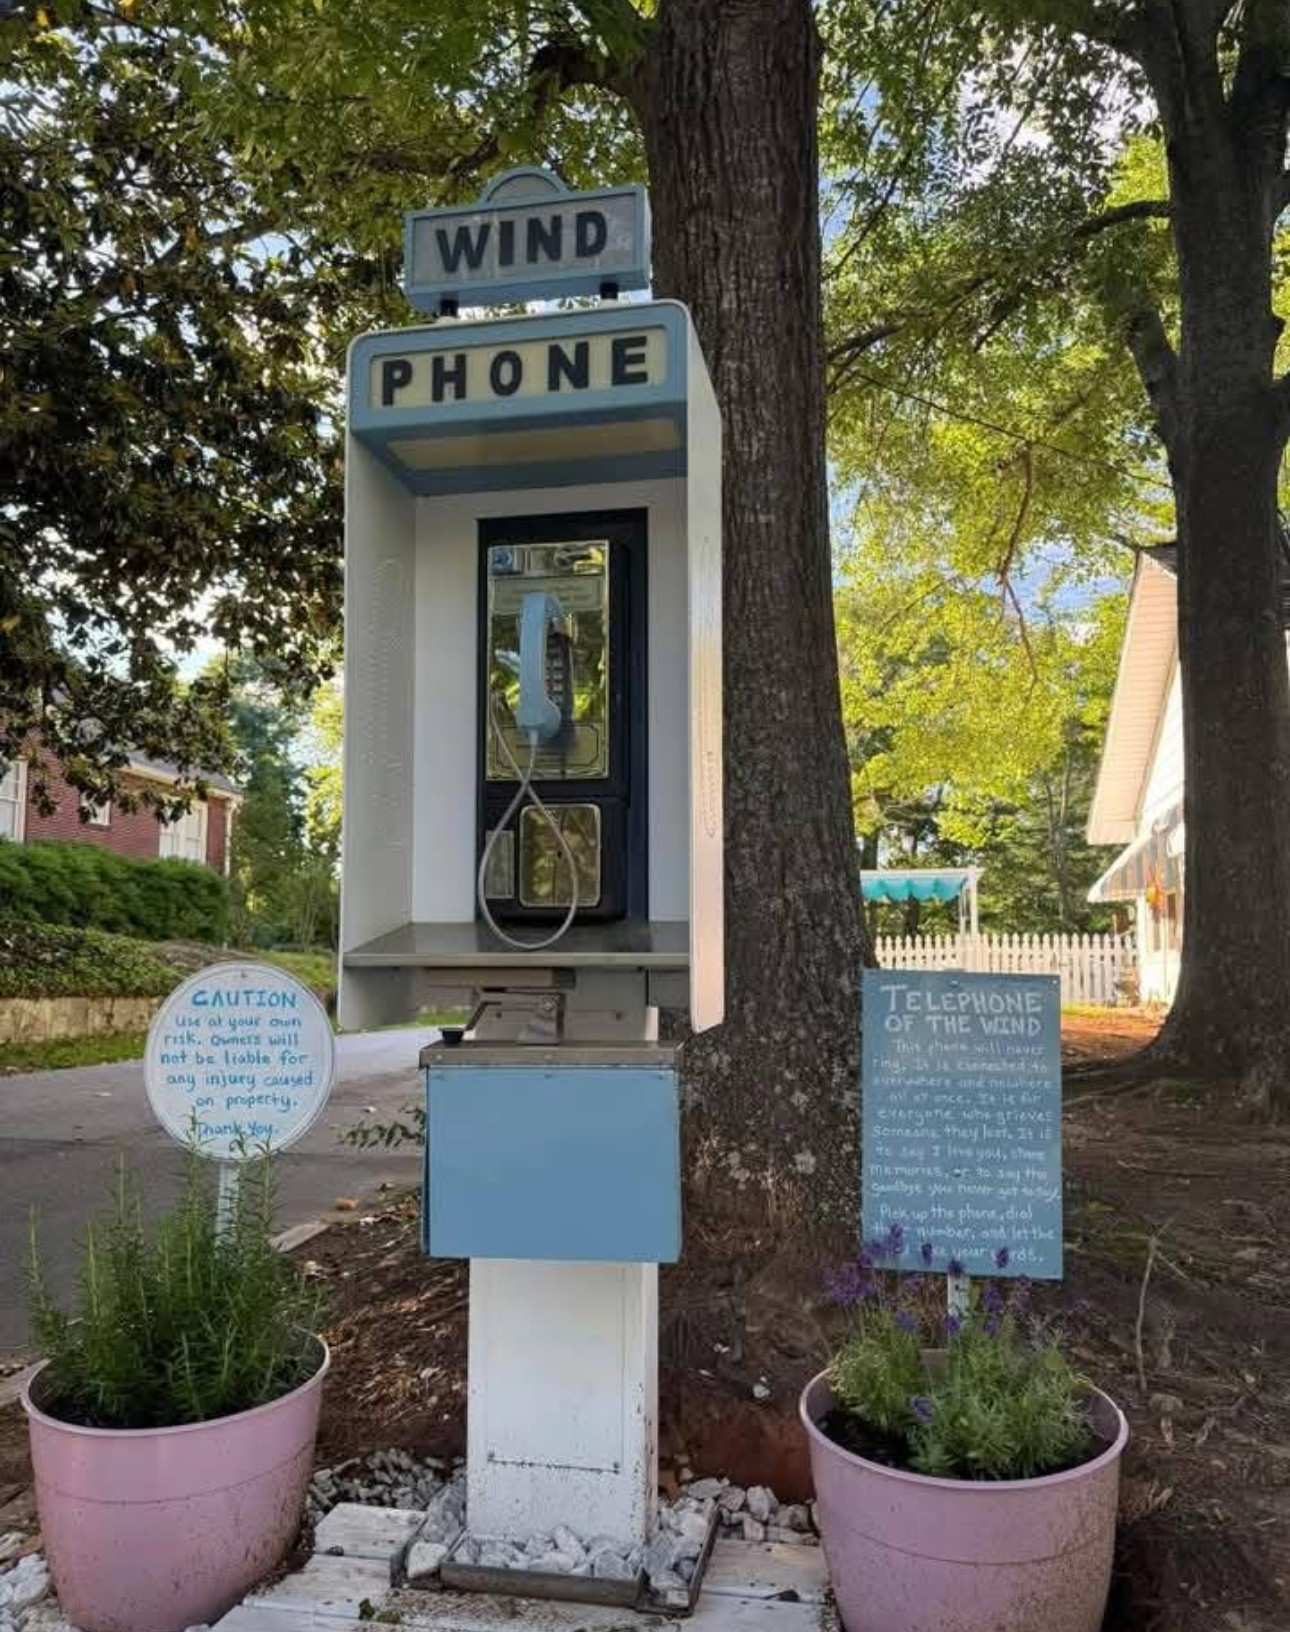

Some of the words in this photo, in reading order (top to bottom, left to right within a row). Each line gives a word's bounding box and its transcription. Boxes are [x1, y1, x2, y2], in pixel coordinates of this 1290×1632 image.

[435, 210, 608, 275] WIND
[381, 335, 650, 406] PHONE
[192, 989, 298, 1008] CAUTION
[880, 984, 1043, 1015] TELEPHONE
[208, 1016, 223, 1027] at
[229, 1017, 261, 1031] your
[269, 1017, 302, 1028] own
[885, 1015, 916, 1033] OF
[924, 1015, 972, 1034] THE
[980, 1016, 1042, 1036] WIND
[164, 1031, 201, 1046] risk.
[269, 1033, 299, 1046] will
[891, 1039, 921, 1054] This
[928, 1040, 968, 1057] phone
[974, 1040, 1001, 1054] will
[1005, 1043, 1047, 1055] never
[160, 1050, 187, 1065] not
[195, 1051, 216, 1064] be
[225, 1050, 271, 1065] liable
[279, 1050, 309, 1065] for
[956, 1058, 1026, 1073] connected
[1031, 1059, 1048, 1074] to
[166, 1074, 196, 1092] any
[205, 1071, 256, 1092] injury
[263, 1071, 313, 1087] caused
[195, 1096, 215, 1108] on
[226, 1093, 298, 1112] property.
[877, 1108, 955, 1126] everyone
[961, 1108, 990, 1122] who
[996, 1109, 1053, 1125] grieves
[945, 1124, 979, 1142] they
[880, 1205, 908, 1220] Pick
[912, 1208, 929, 1223] up
[930, 1205, 954, 1220] the
[1005, 1203, 1034, 1221] dial
[980, 1224, 1006, 1240] and
[1029, 1224, 1056, 1240] the
